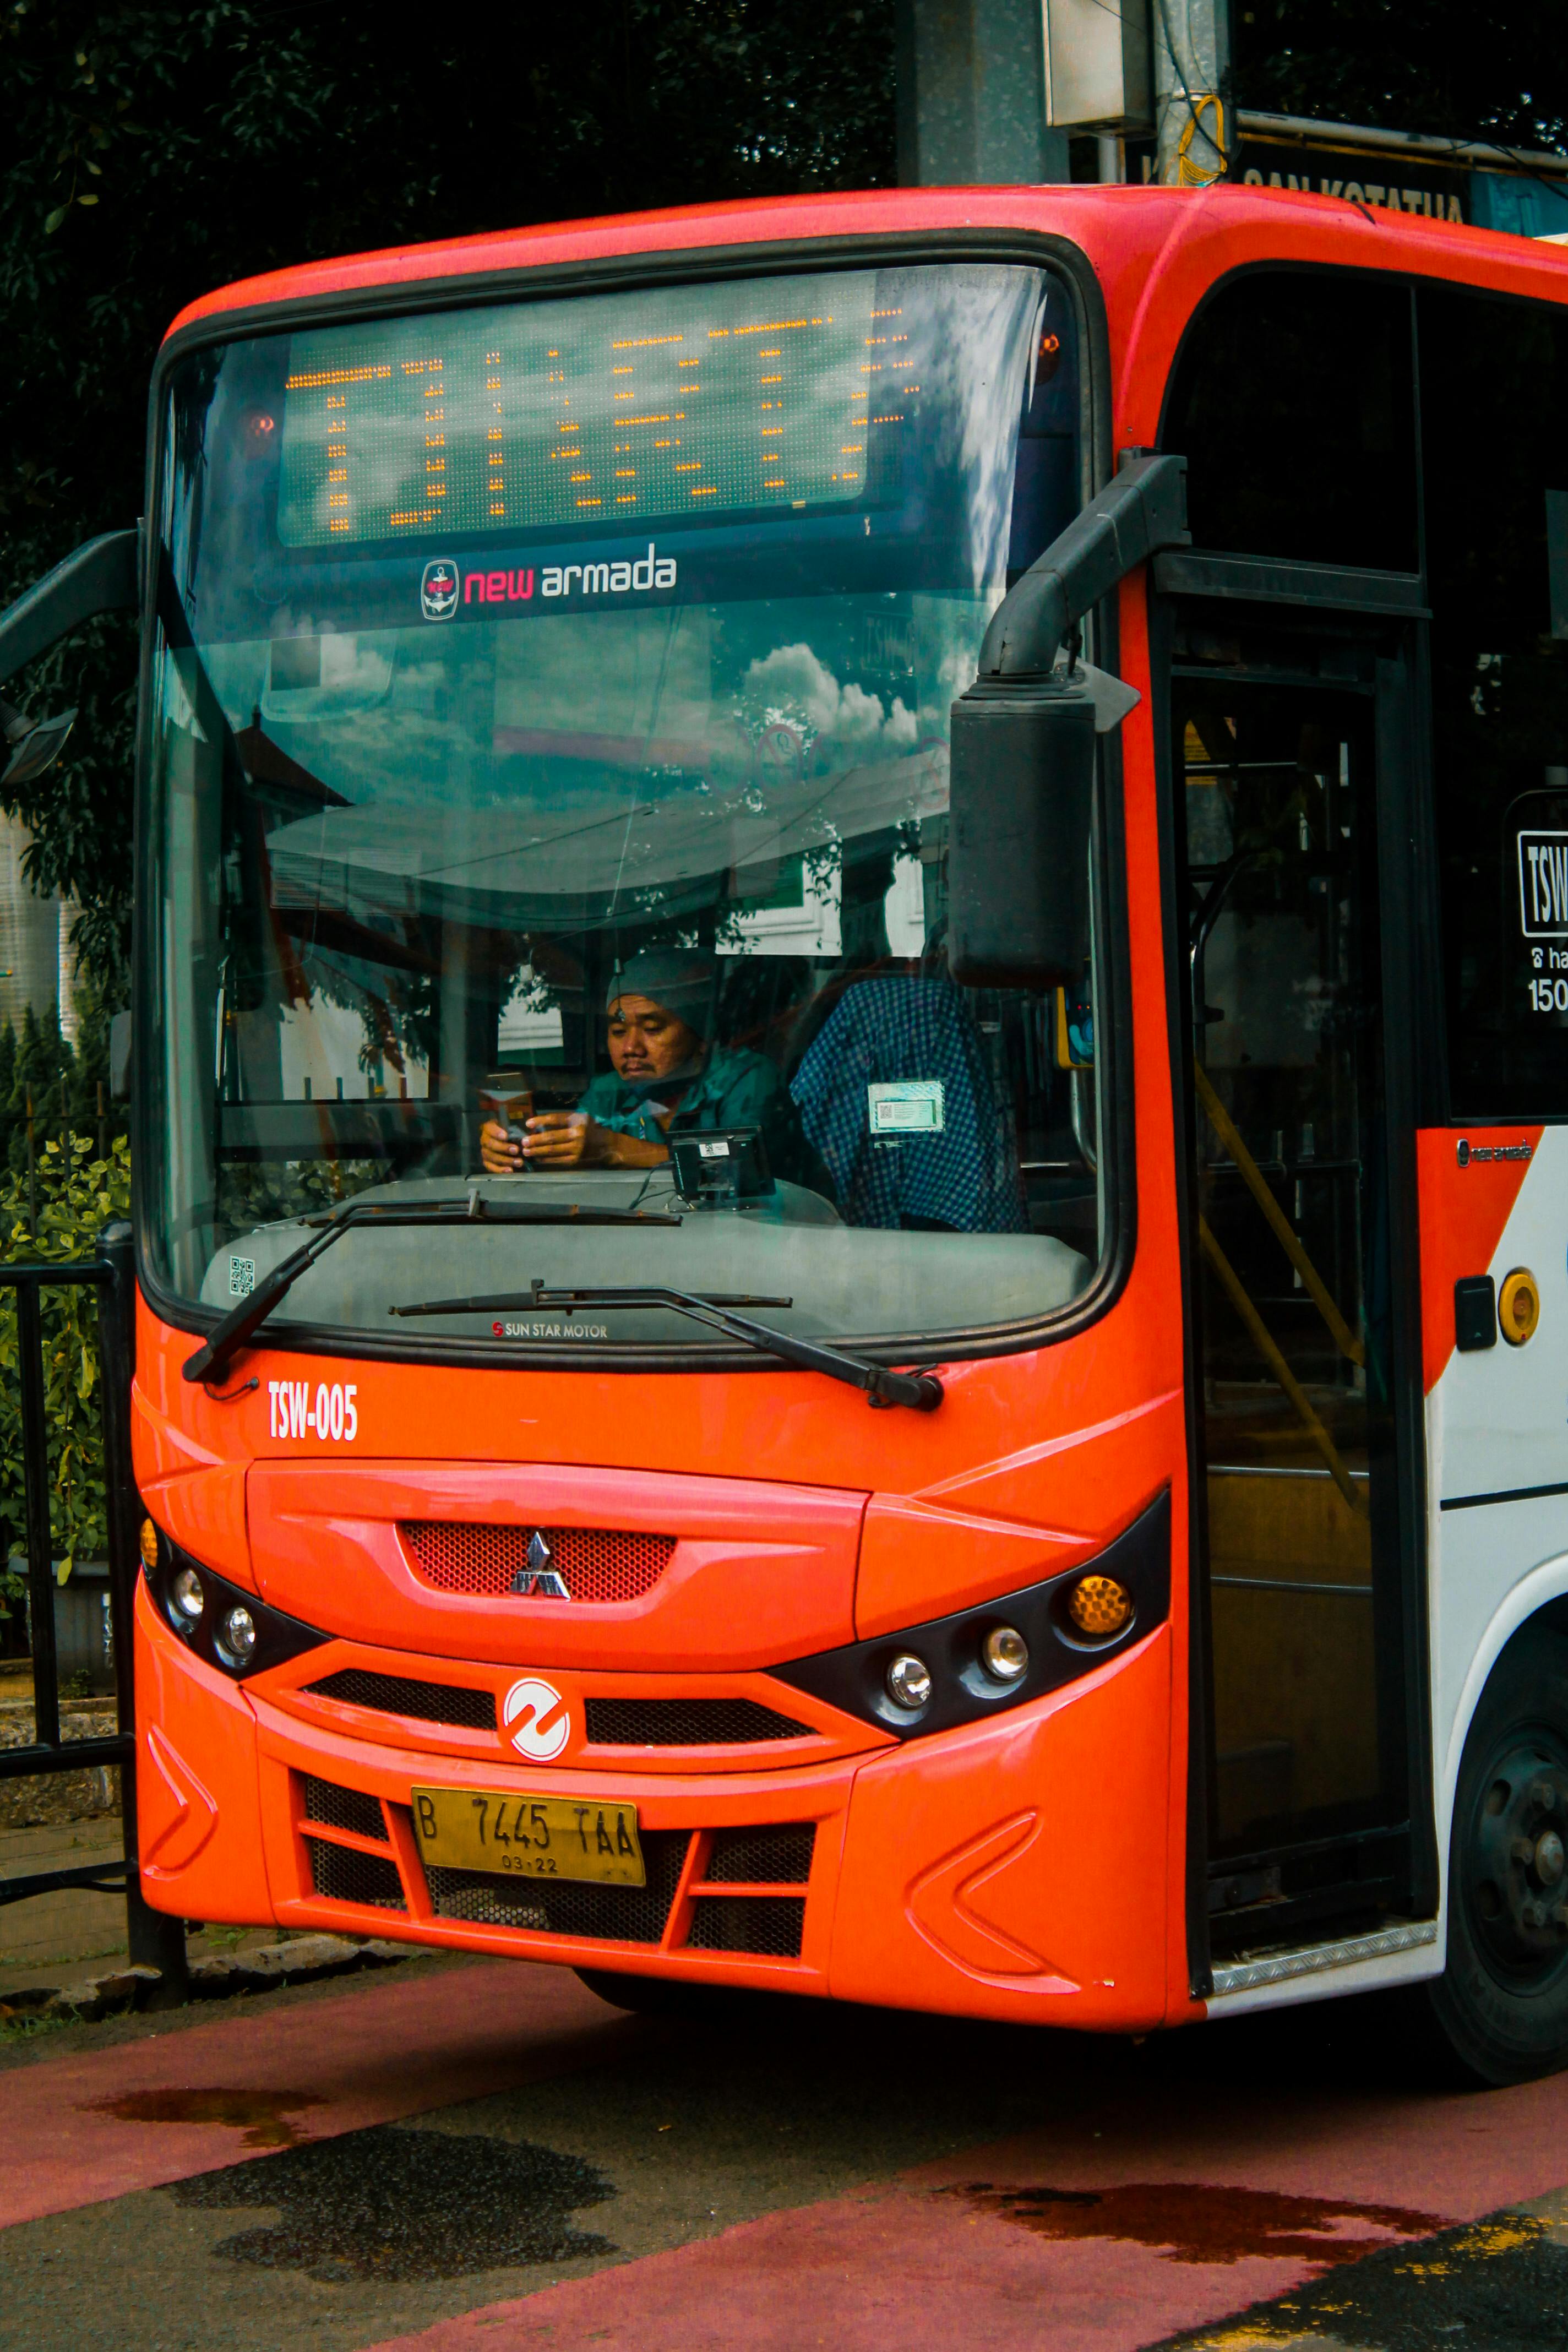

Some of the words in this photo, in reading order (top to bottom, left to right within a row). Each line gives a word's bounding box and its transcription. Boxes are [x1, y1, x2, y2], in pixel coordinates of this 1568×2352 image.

[465, 569, 533, 604] new
[542, 543, 676, 596] armada
[505, 1322, 530, 1336] SUN
[532, 1324, 561, 1337] STAR
[564, 1325, 607, 1338] MOTOR
[268, 1381, 357, 1441] TSW-005
[417, 1795, 437, 1839] B
[472, 1798, 550, 1849] 7445
[574, 1807, 635, 1857] TAA
